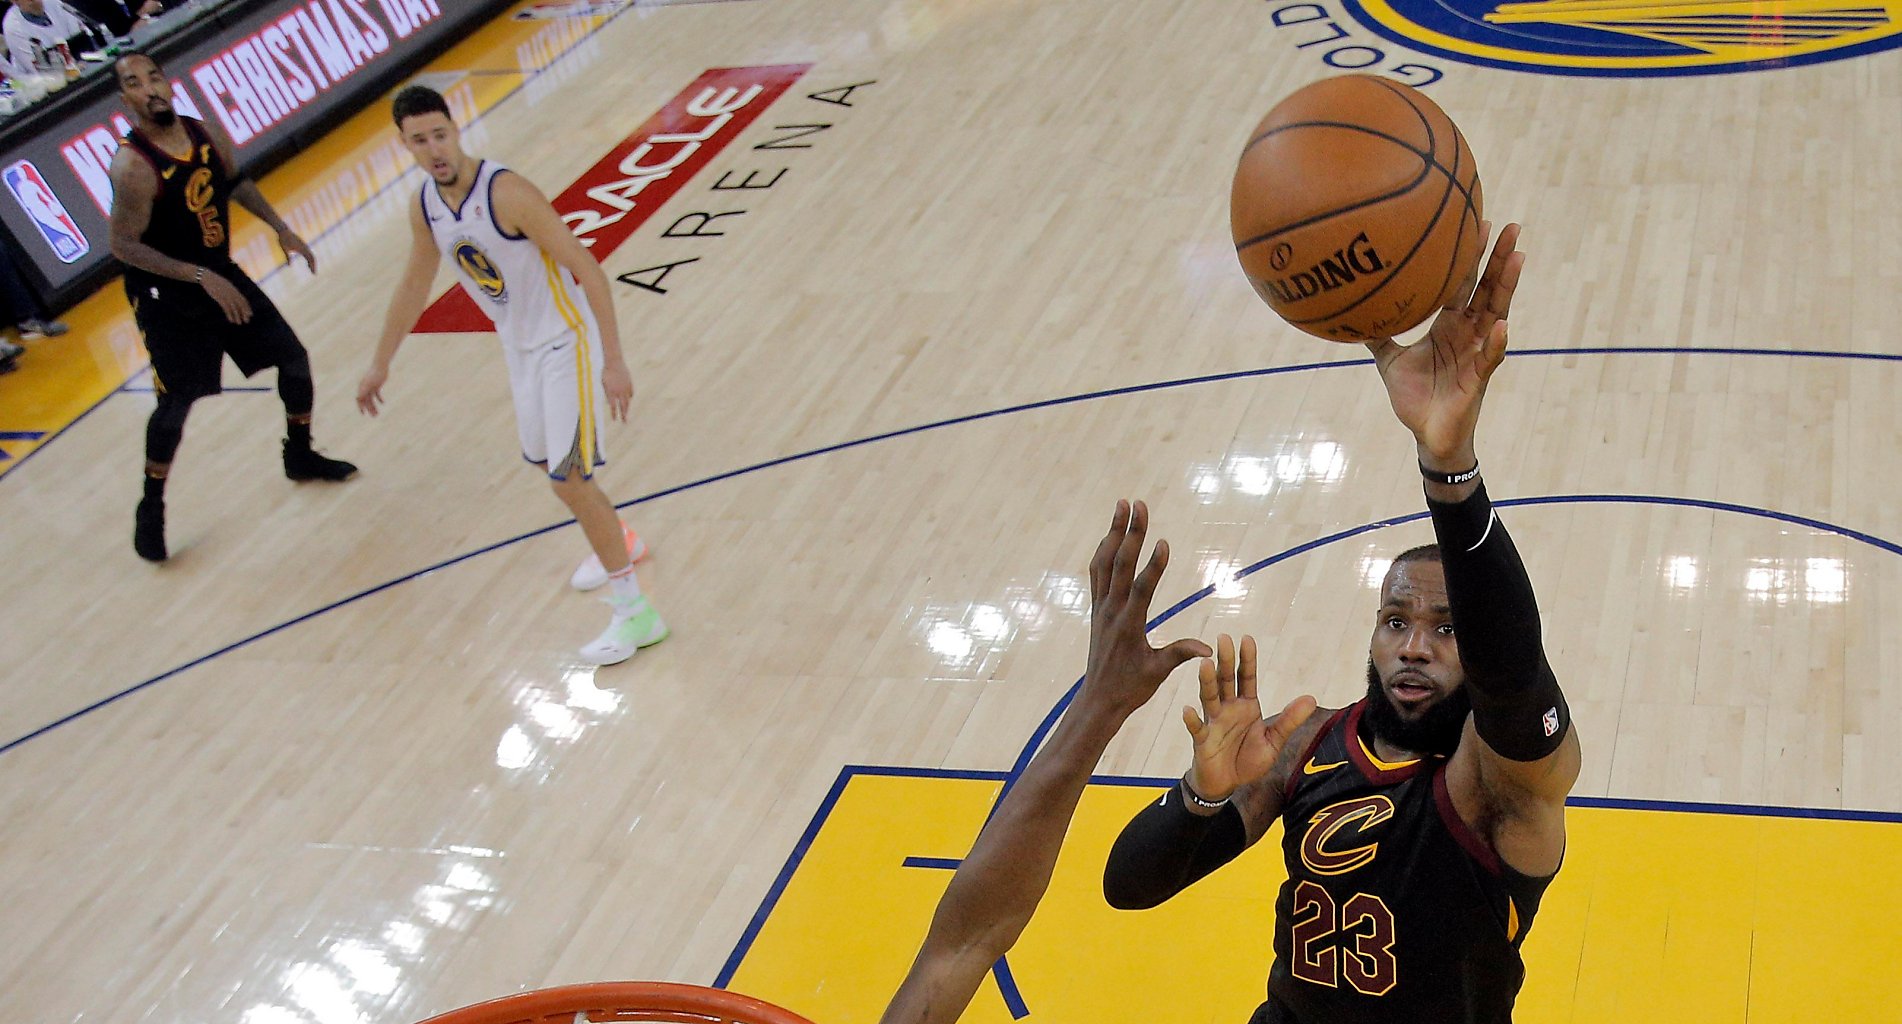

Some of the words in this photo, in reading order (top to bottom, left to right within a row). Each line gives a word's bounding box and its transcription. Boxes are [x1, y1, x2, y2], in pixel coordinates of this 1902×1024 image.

[190, 0, 390, 146] CHRISTMAS
[1265, 0, 1443, 88] GOLD
[561, 83, 765, 248] RACLE
[616, 80, 878, 295] ARENA
[1262, 231, 1384, 304] ALDING
[1300, 794, 1395, 876] C
[1291, 880, 1397, 997] 23
